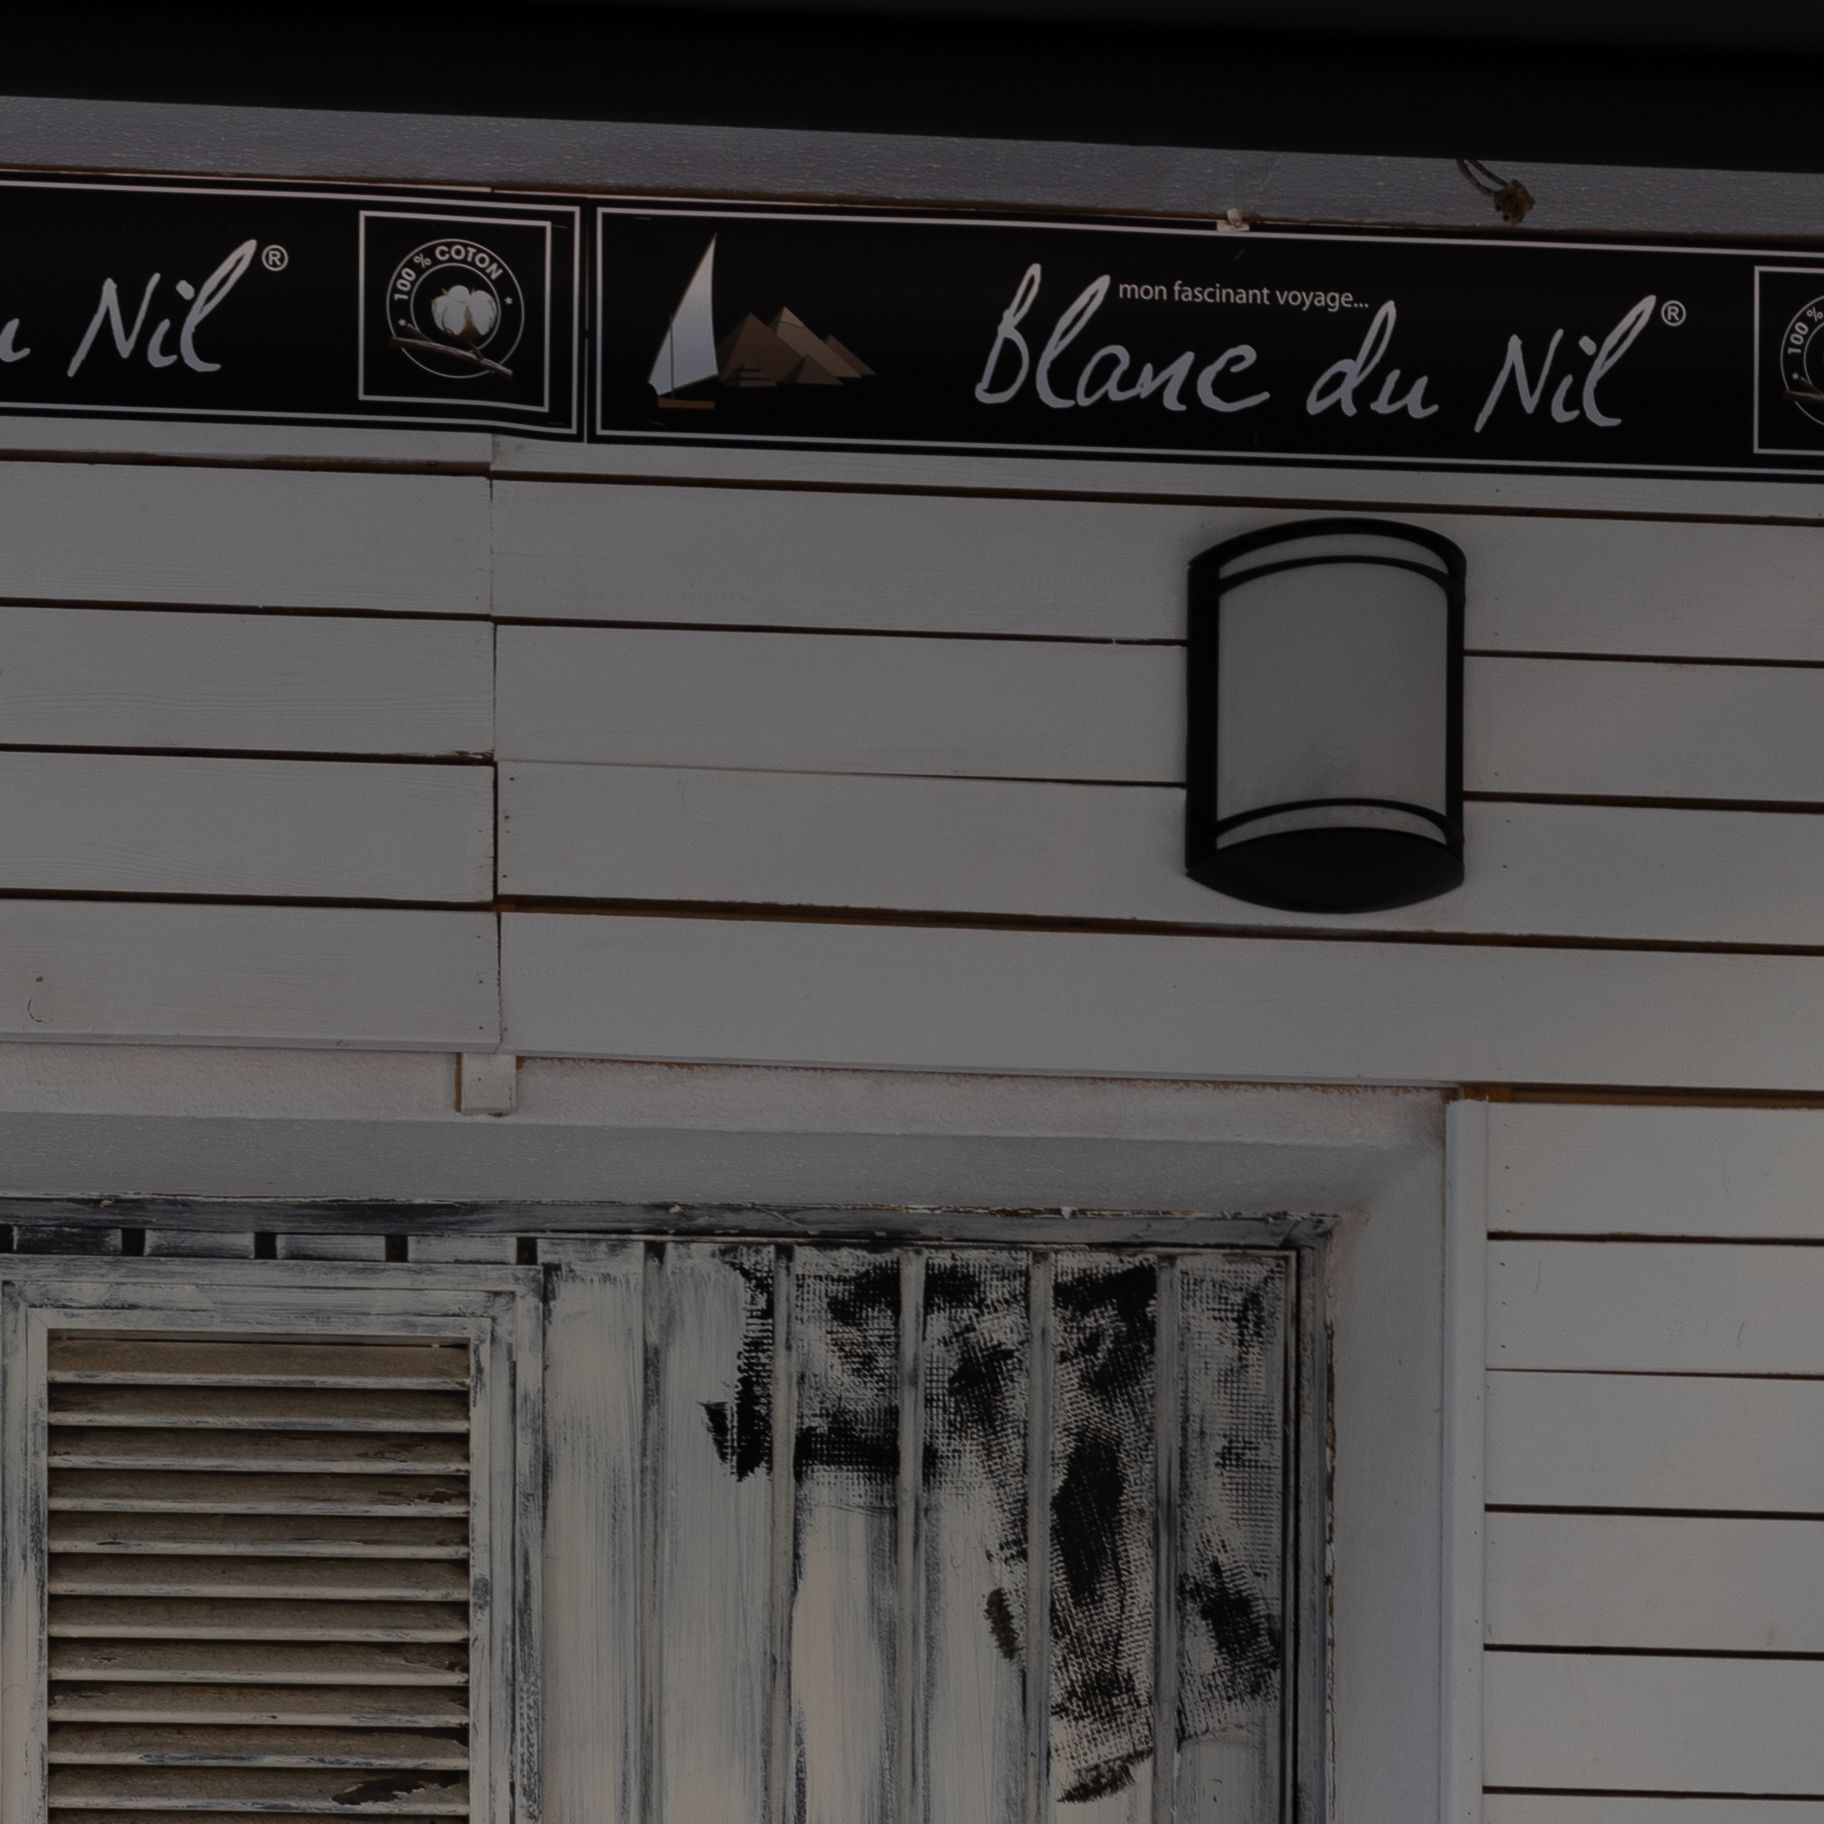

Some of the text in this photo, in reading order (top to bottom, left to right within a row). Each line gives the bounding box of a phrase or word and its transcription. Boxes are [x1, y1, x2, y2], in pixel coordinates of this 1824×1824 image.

[393, 267, 417, 300] 100
[434, 244, 504, 280] COTON
[1119, 280, 1369, 313] mon fascinant voyage...
[974, 262, 1271, 413] Blanc
[1306, 299, 1439, 419] du
[1787, 321, 1809, 354] 100
